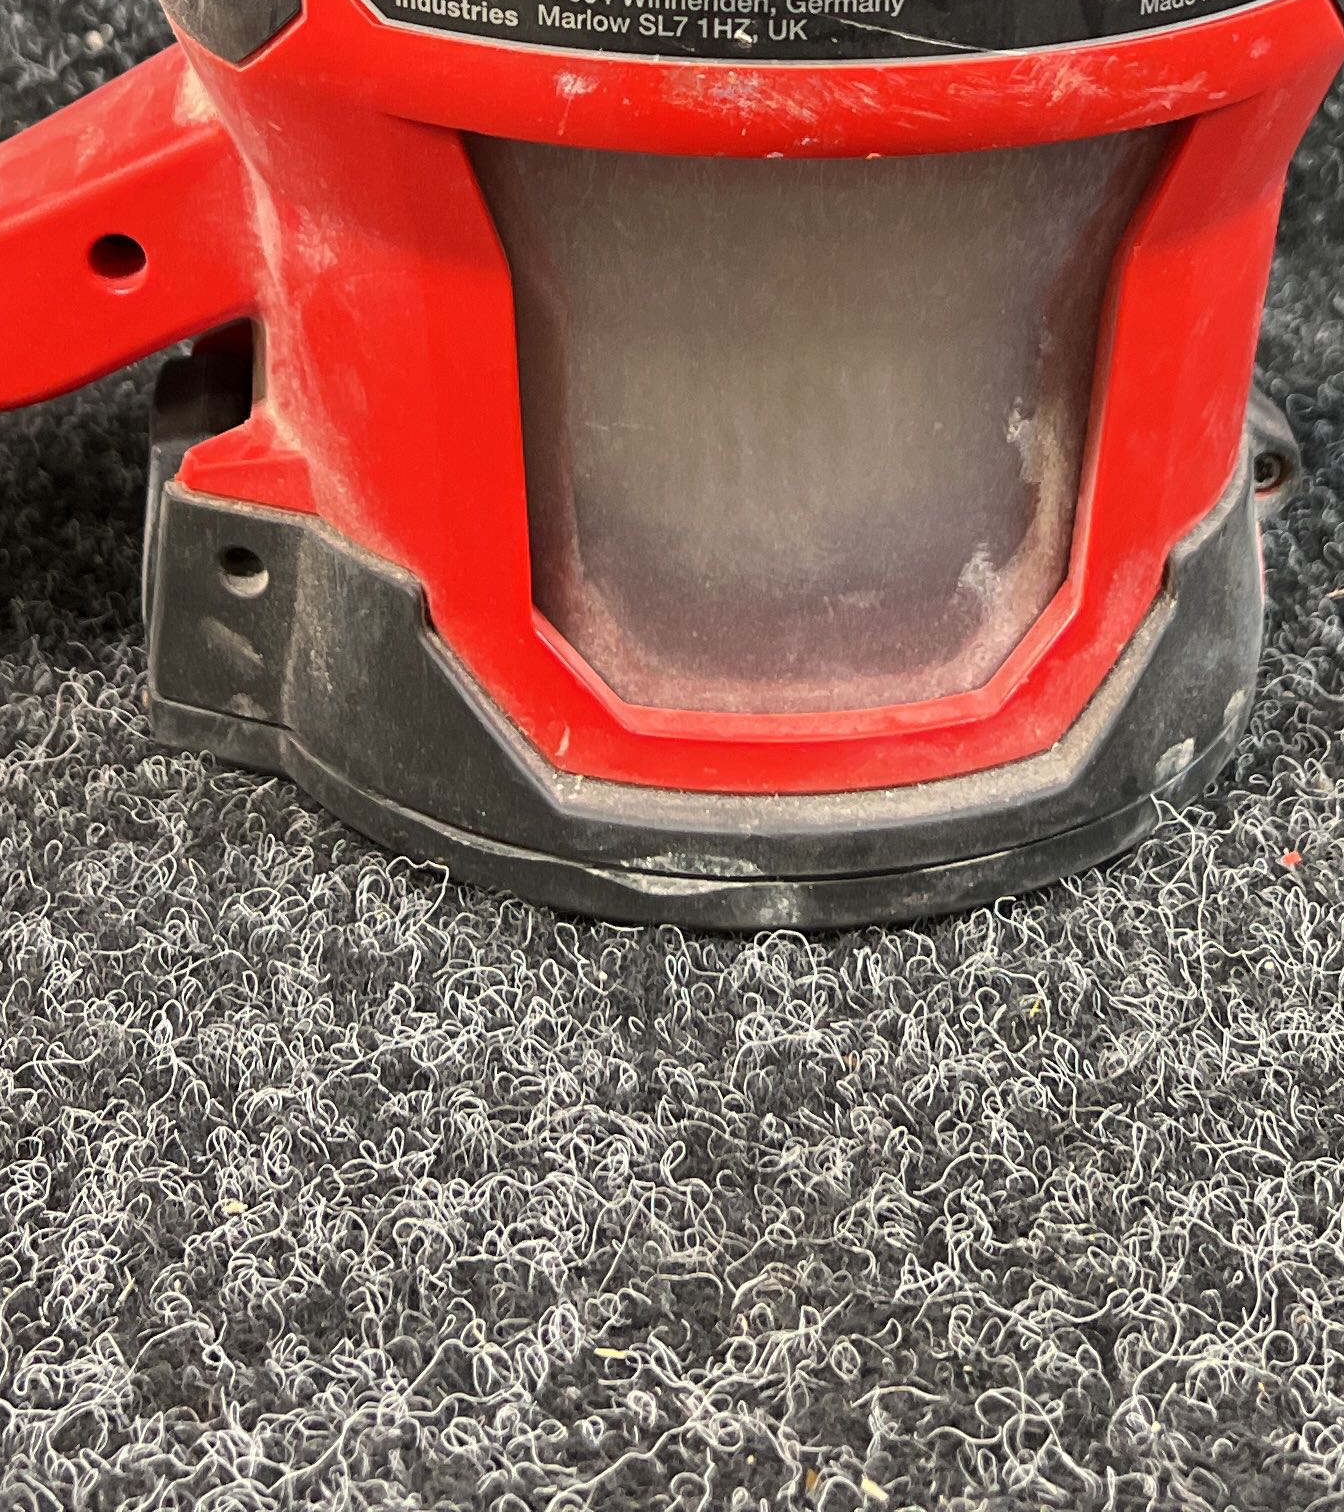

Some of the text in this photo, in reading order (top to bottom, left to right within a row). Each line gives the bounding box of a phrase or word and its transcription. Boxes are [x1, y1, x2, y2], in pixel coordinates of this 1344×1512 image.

[537, 4, 630, 35] Marlow
[639, 13, 688, 37] SL7
[769, 18, 808, 42] UK
